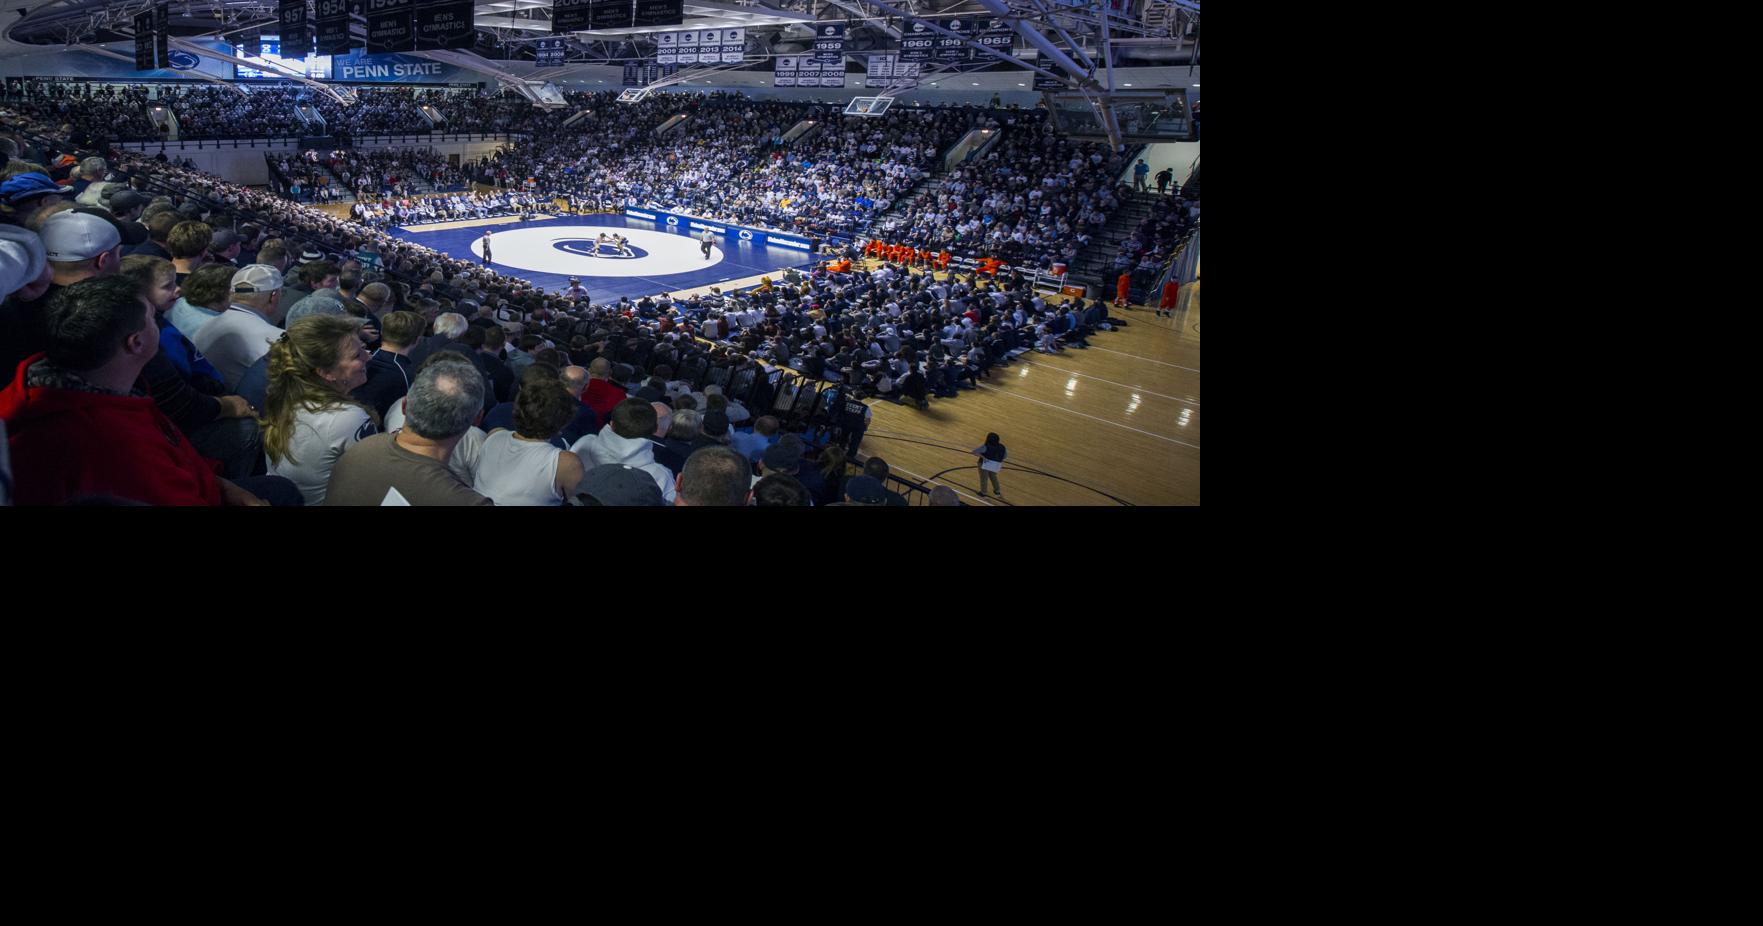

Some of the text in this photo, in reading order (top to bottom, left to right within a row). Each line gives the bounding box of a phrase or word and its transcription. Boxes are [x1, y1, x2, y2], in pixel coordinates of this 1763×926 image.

[902, 39, 933, 48] 1960
[977, 36, 1011, 45] 1965
[722, 45, 743, 53] 2014
[816, 42, 842, 50] 1959
[336, 57, 373, 66] WE ARE
[343, 63, 442, 79] PENN STATE
